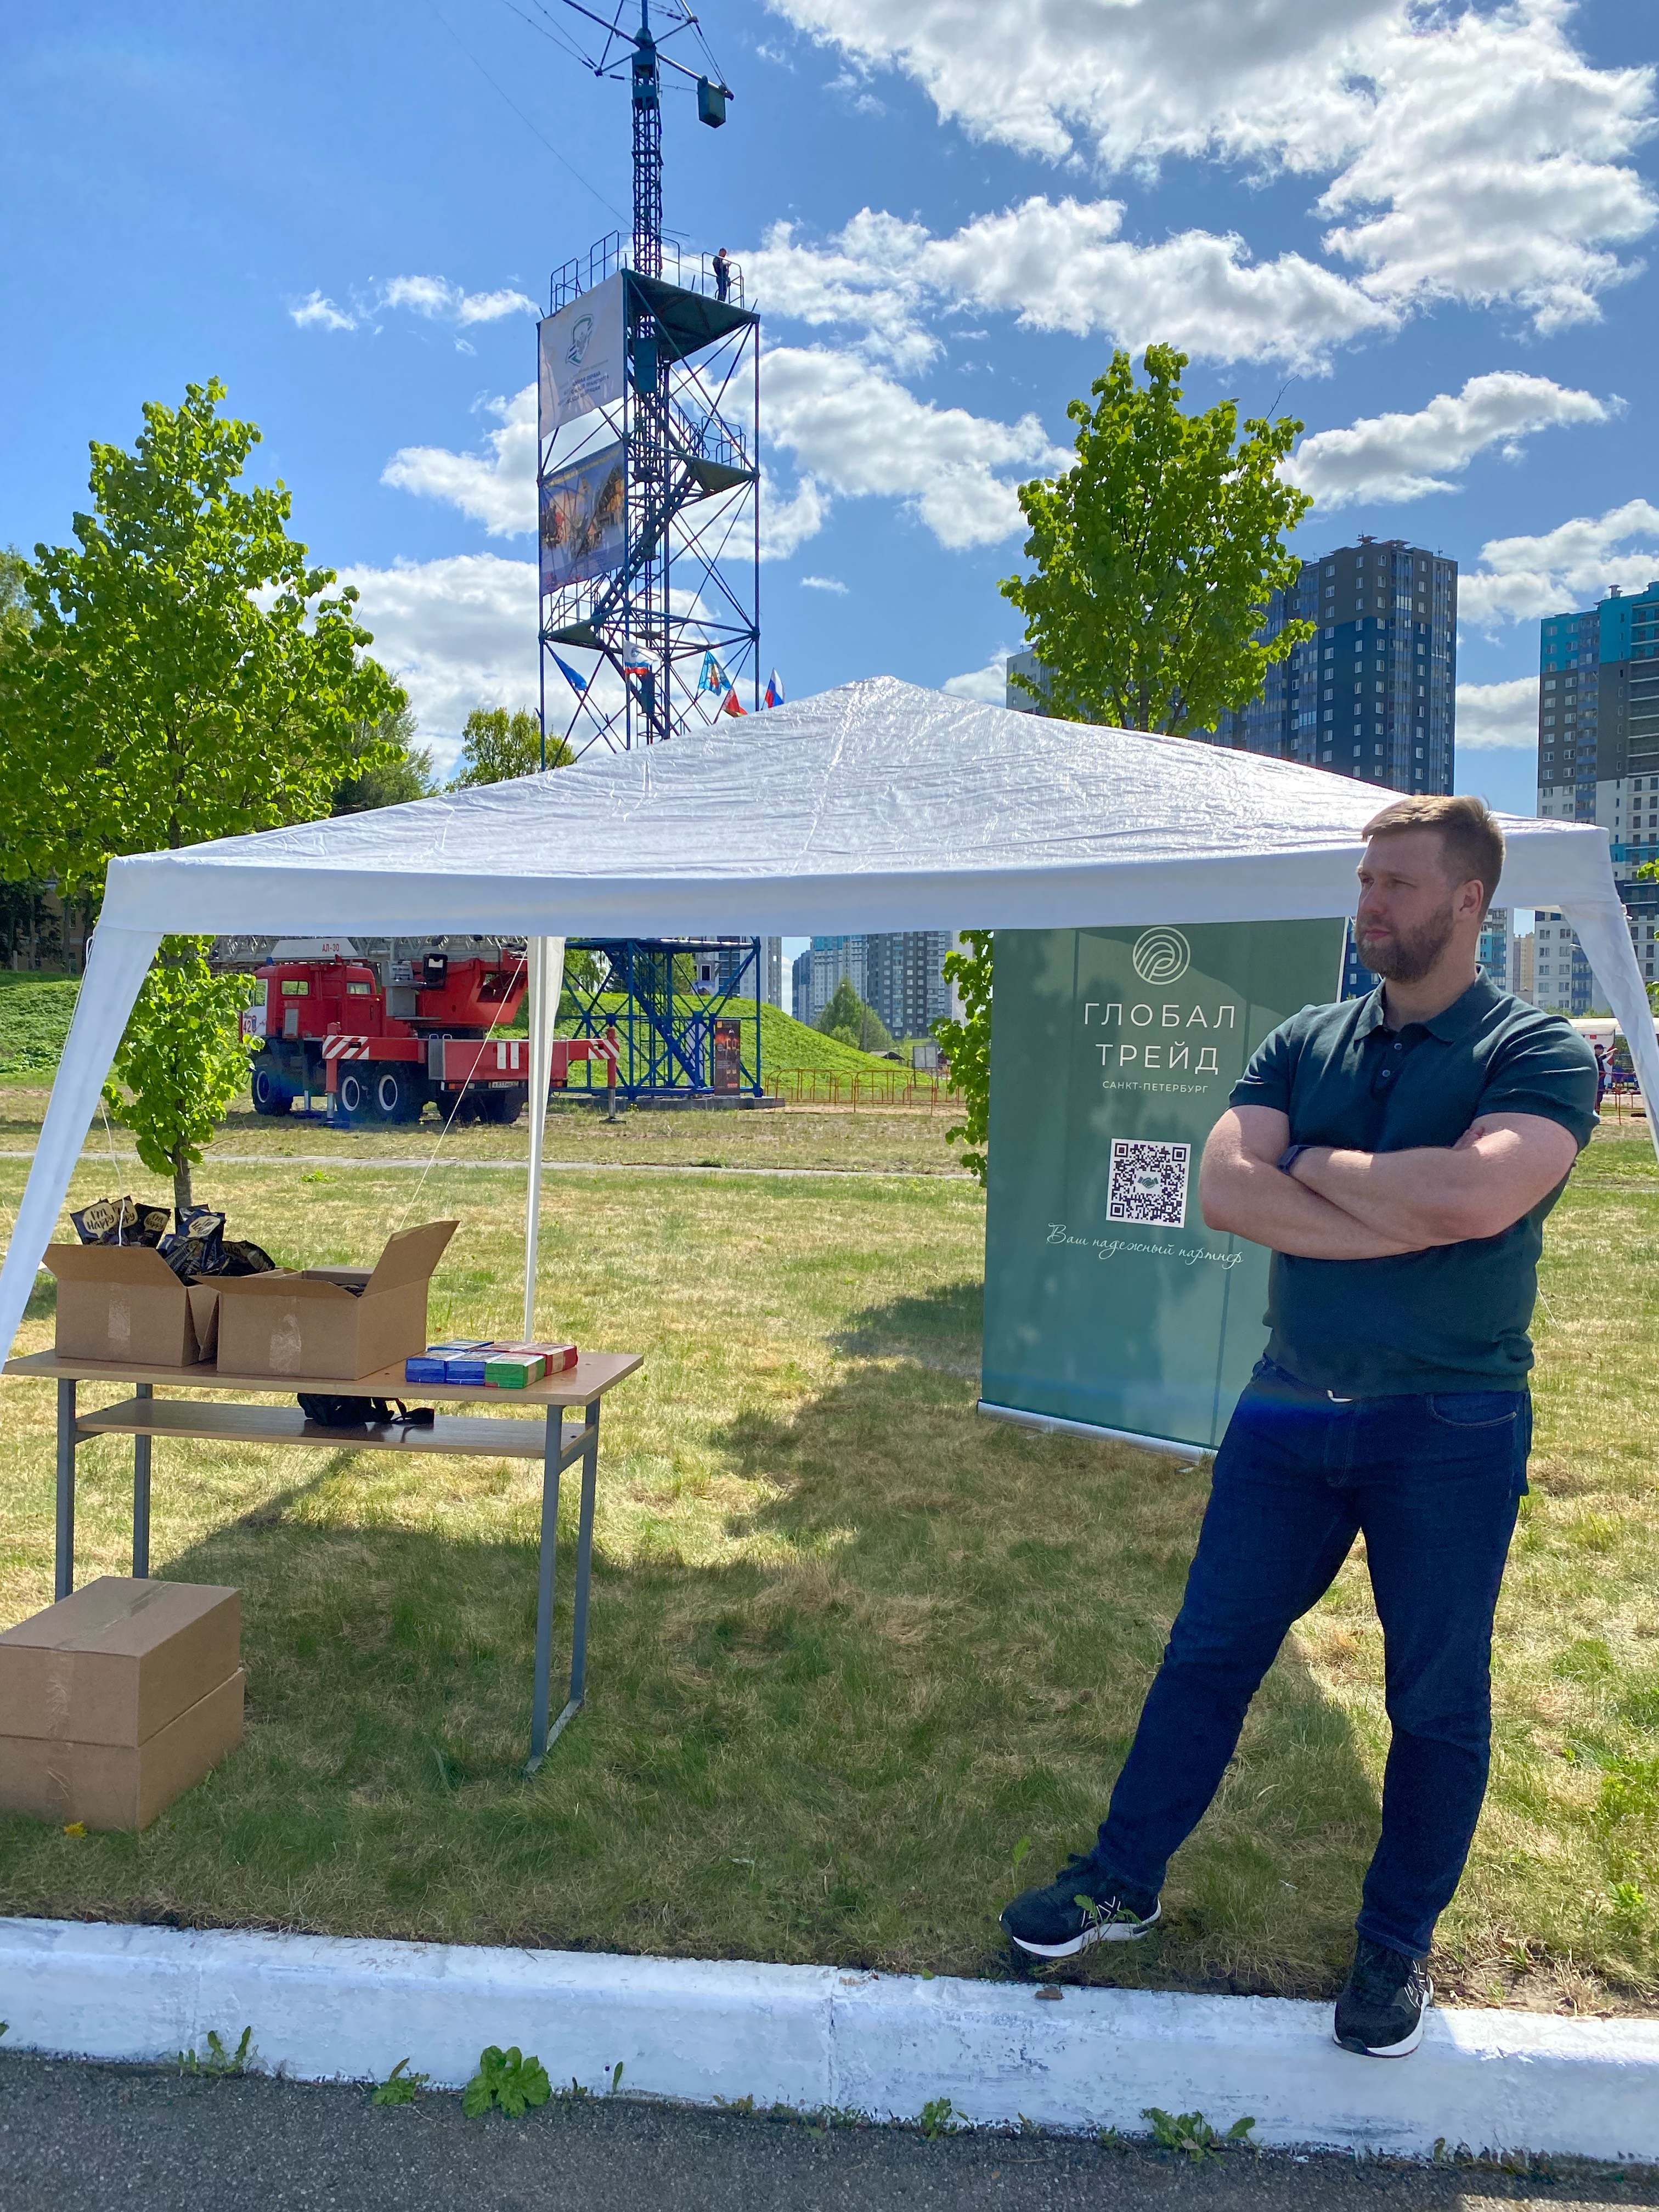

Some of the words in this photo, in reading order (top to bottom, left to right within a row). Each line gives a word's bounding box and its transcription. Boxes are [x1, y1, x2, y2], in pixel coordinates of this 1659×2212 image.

[322, 943, 340, 952] АЛ-30
[1084, 1002, 1235, 1029] ГЛОБАЛ
[243, 1020, 251, 1032] 42
[1095, 1041, 1218, 1075] ТРЕЙД
[1102, 1080, 1209, 1094] САНКТ-ПЕТЕРБУРГ
[90, 1207, 107, 1221] I'm
[87, 1214, 115, 1230] Happy
[1046, 1222, 1088, 1244] Ваш
[1092, 1239, 1175, 1260] надежный
[1178, 1246, 1245, 1269] партнер
